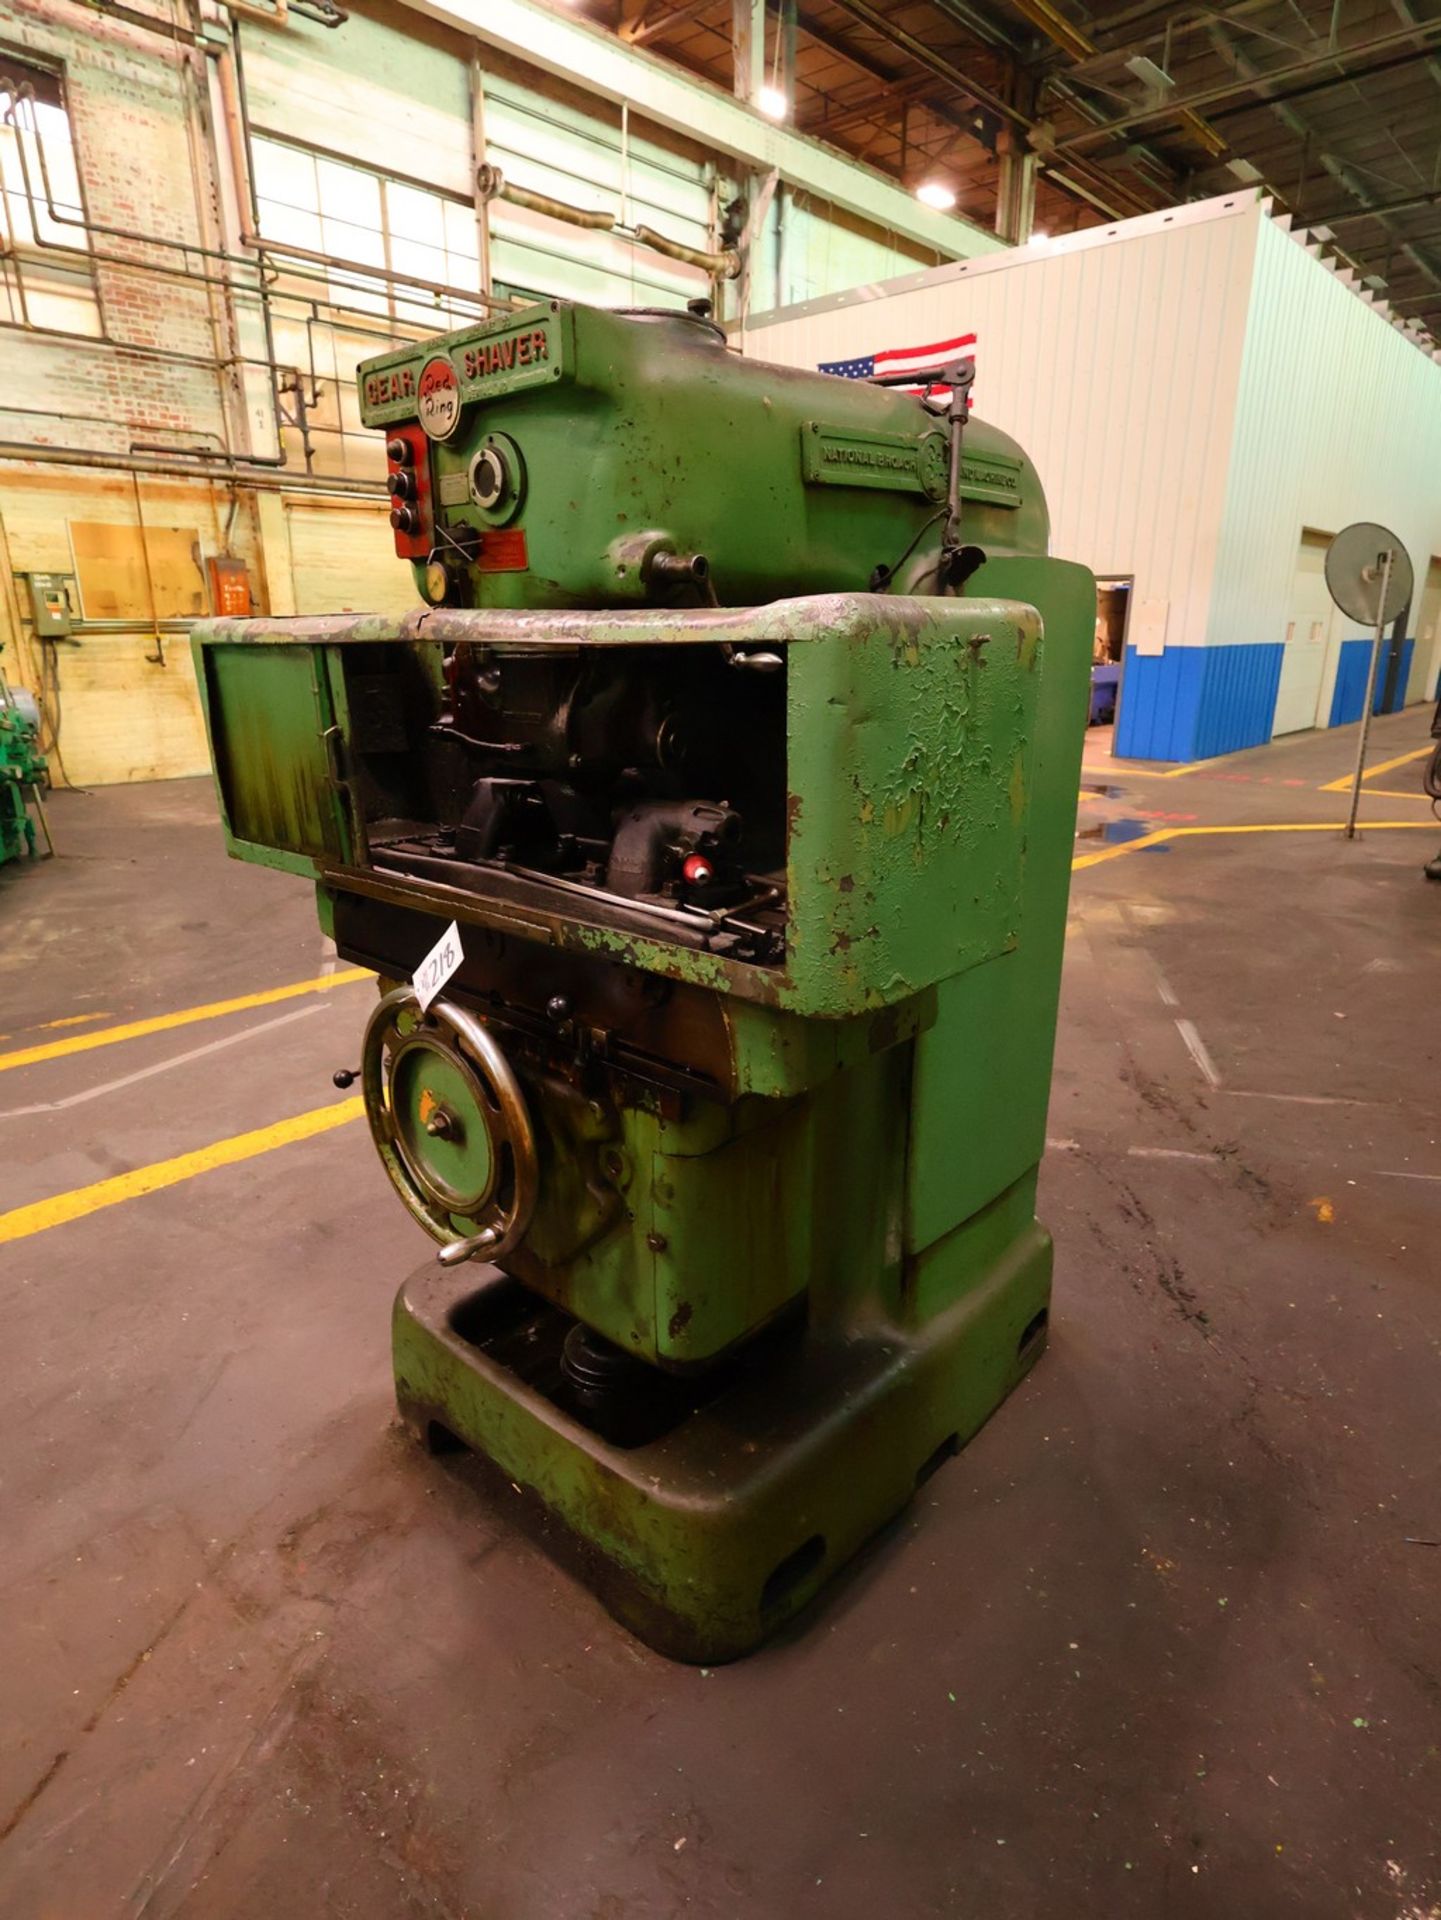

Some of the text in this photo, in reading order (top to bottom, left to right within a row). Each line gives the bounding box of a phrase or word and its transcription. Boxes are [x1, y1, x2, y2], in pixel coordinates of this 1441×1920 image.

[366, 328, 549, 406] GEAR SHAVER
[423, 374, 452, 396] Red
[425, 398, 454, 420] Ring
[822, 446, 876, 467] NATIONAL
[877, 454, 918, 472] BROACH
